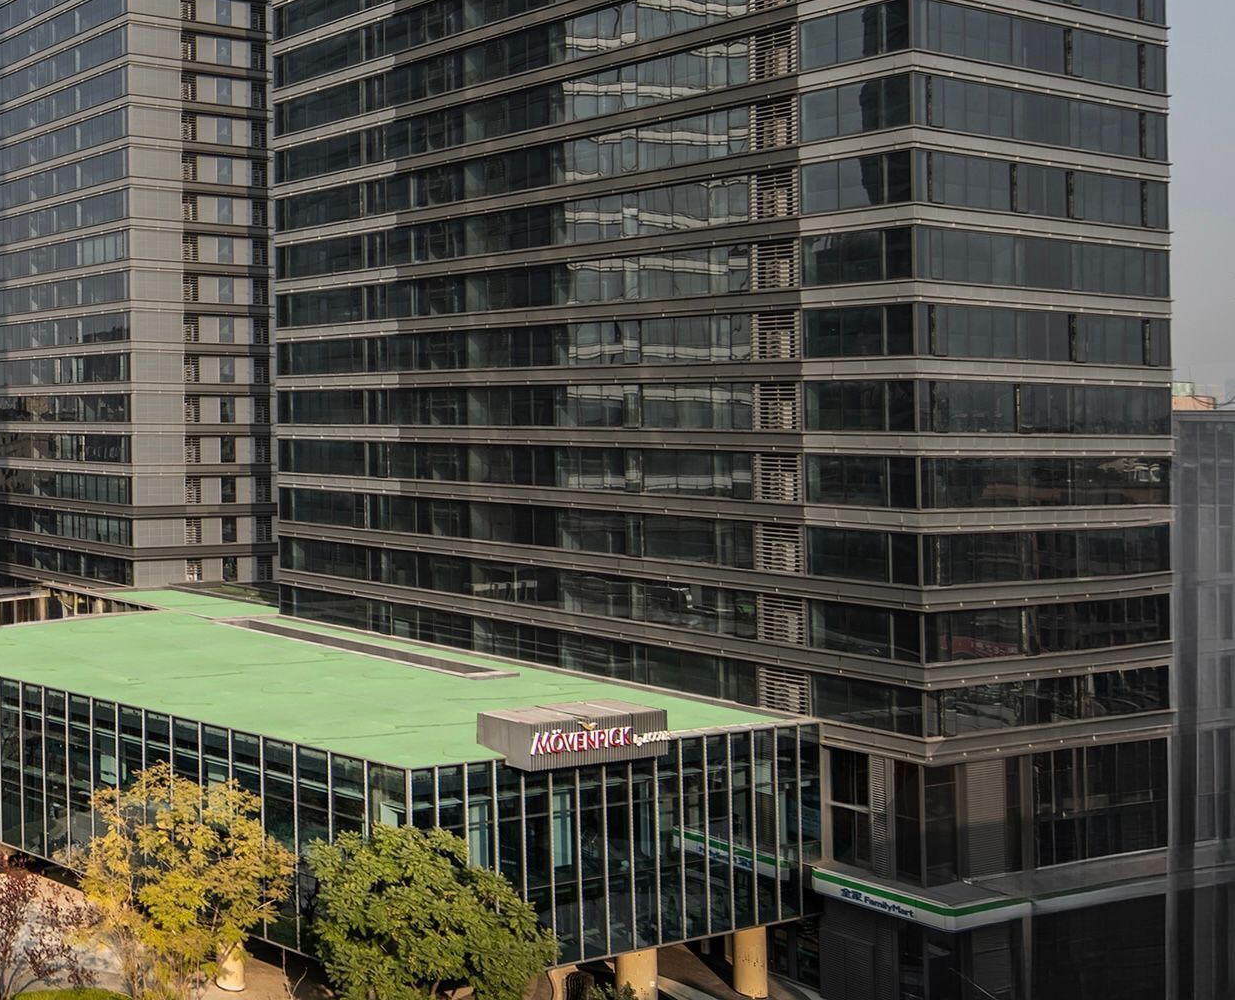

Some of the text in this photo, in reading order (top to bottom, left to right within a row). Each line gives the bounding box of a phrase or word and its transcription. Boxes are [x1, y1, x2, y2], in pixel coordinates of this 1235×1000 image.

[530, 726, 634, 756] MÖVENPICK
[841, 888, 914, 916] 全家 FamilyMart
